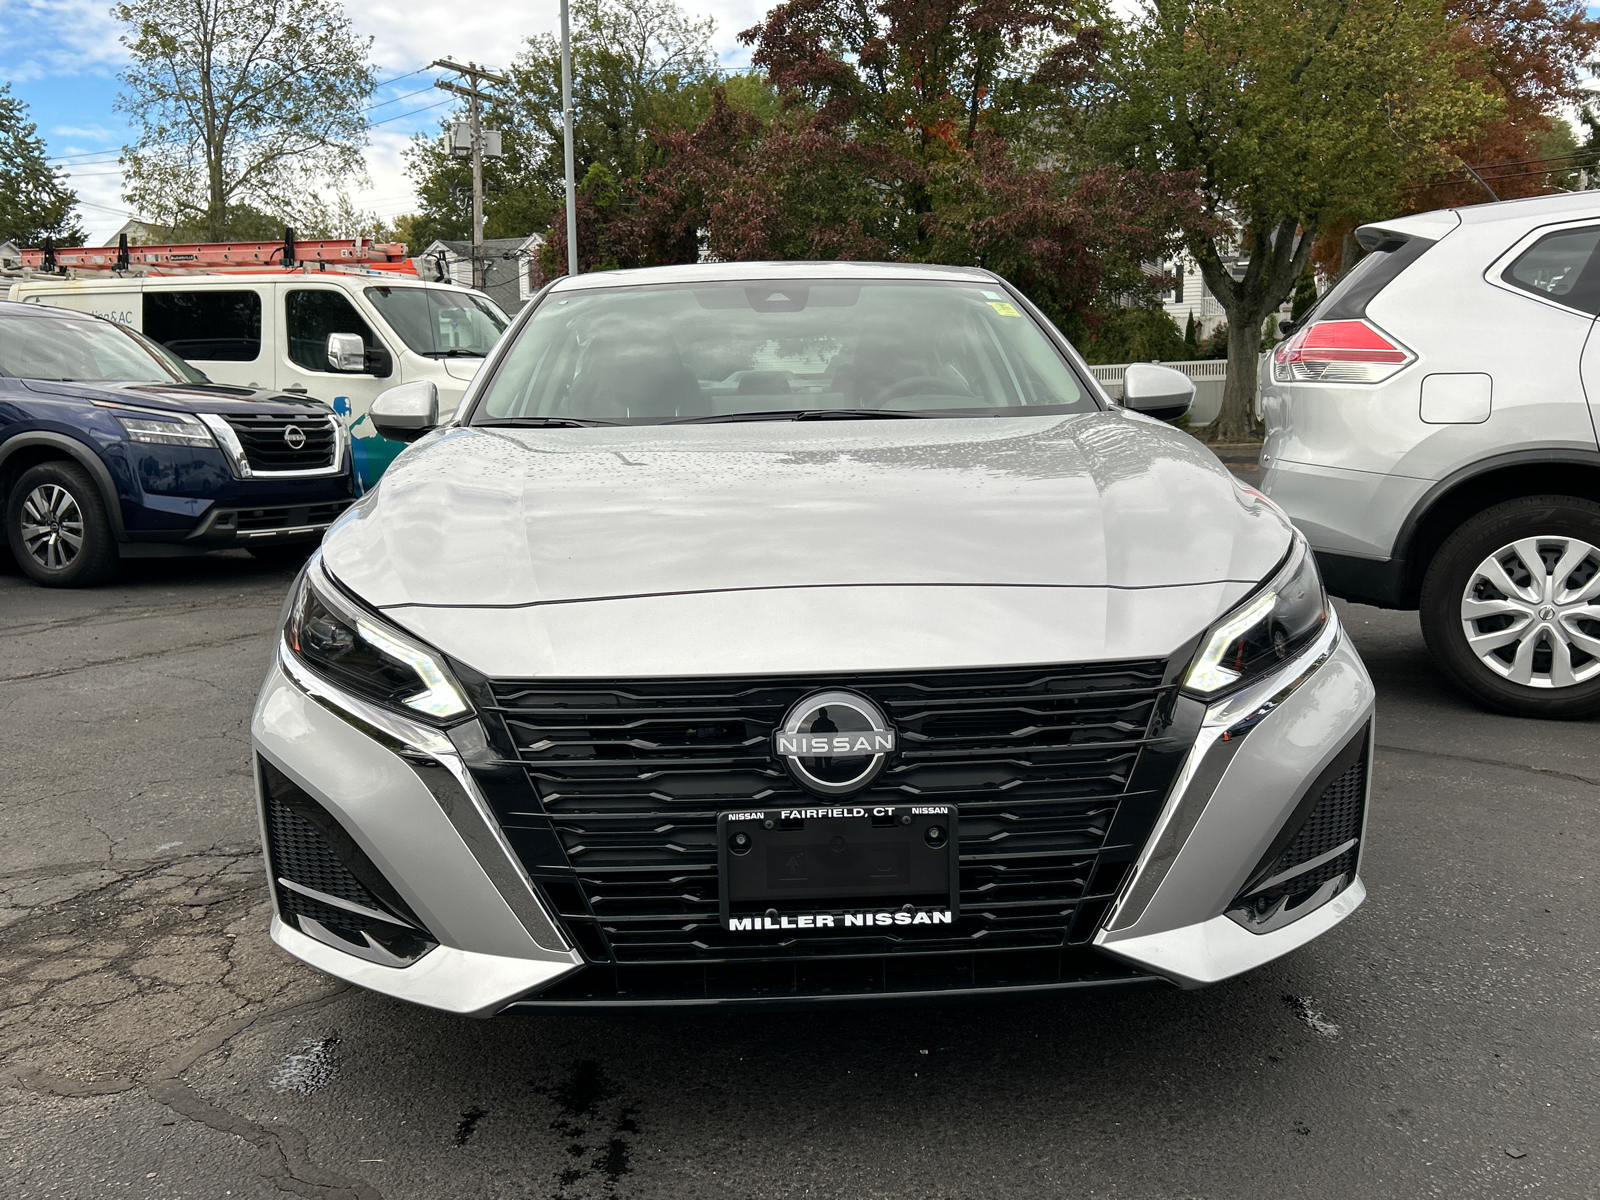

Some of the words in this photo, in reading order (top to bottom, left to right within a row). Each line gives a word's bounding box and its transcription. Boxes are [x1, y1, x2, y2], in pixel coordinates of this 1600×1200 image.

[779, 734, 893, 753] NISSAN
[728, 811, 765, 821] NISSAN
[780, 807, 869, 820] FAIRFIELD,
[872, 806, 896, 817] CT
[911, 806, 949, 815] NISSAN
[728, 914, 835, 931] MILLER
[844, 911, 953, 927] NISSAN
